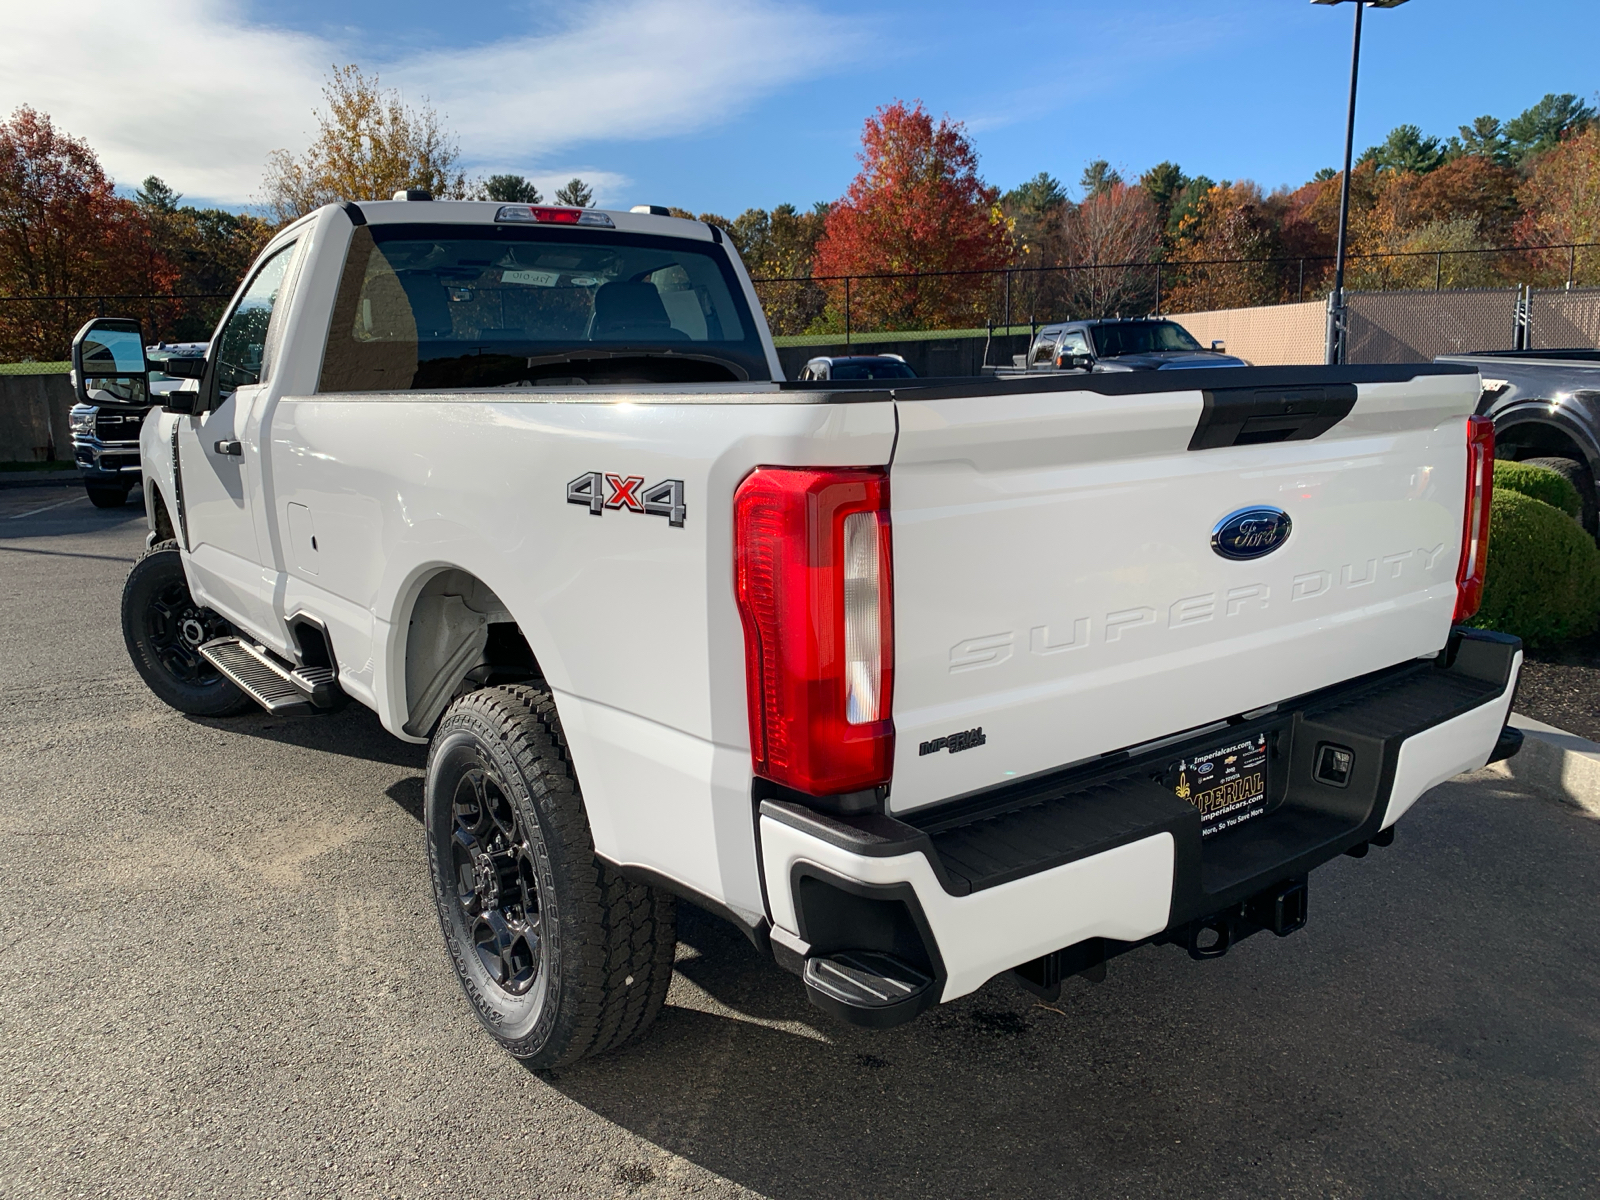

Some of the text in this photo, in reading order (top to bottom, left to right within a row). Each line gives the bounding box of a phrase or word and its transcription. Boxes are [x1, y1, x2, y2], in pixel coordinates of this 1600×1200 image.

[1235, 518, 1277, 548] Ford
[949, 542, 1446, 675] SUPER DUTY
[919, 726, 987, 756] IMPERIAL
[1194, 740, 1252, 764] Imperialcars.com
[1225, 766, 1236, 774] Jeep
[1225, 773, 1241, 783] TOYOTA
[1186, 772, 1264, 815] MPERIAL
[1218, 823, 1226, 831] So
[1226, 818, 1237, 827] You
[1237, 813, 1250, 823] Save
[1250, 807, 1264, 818] More
